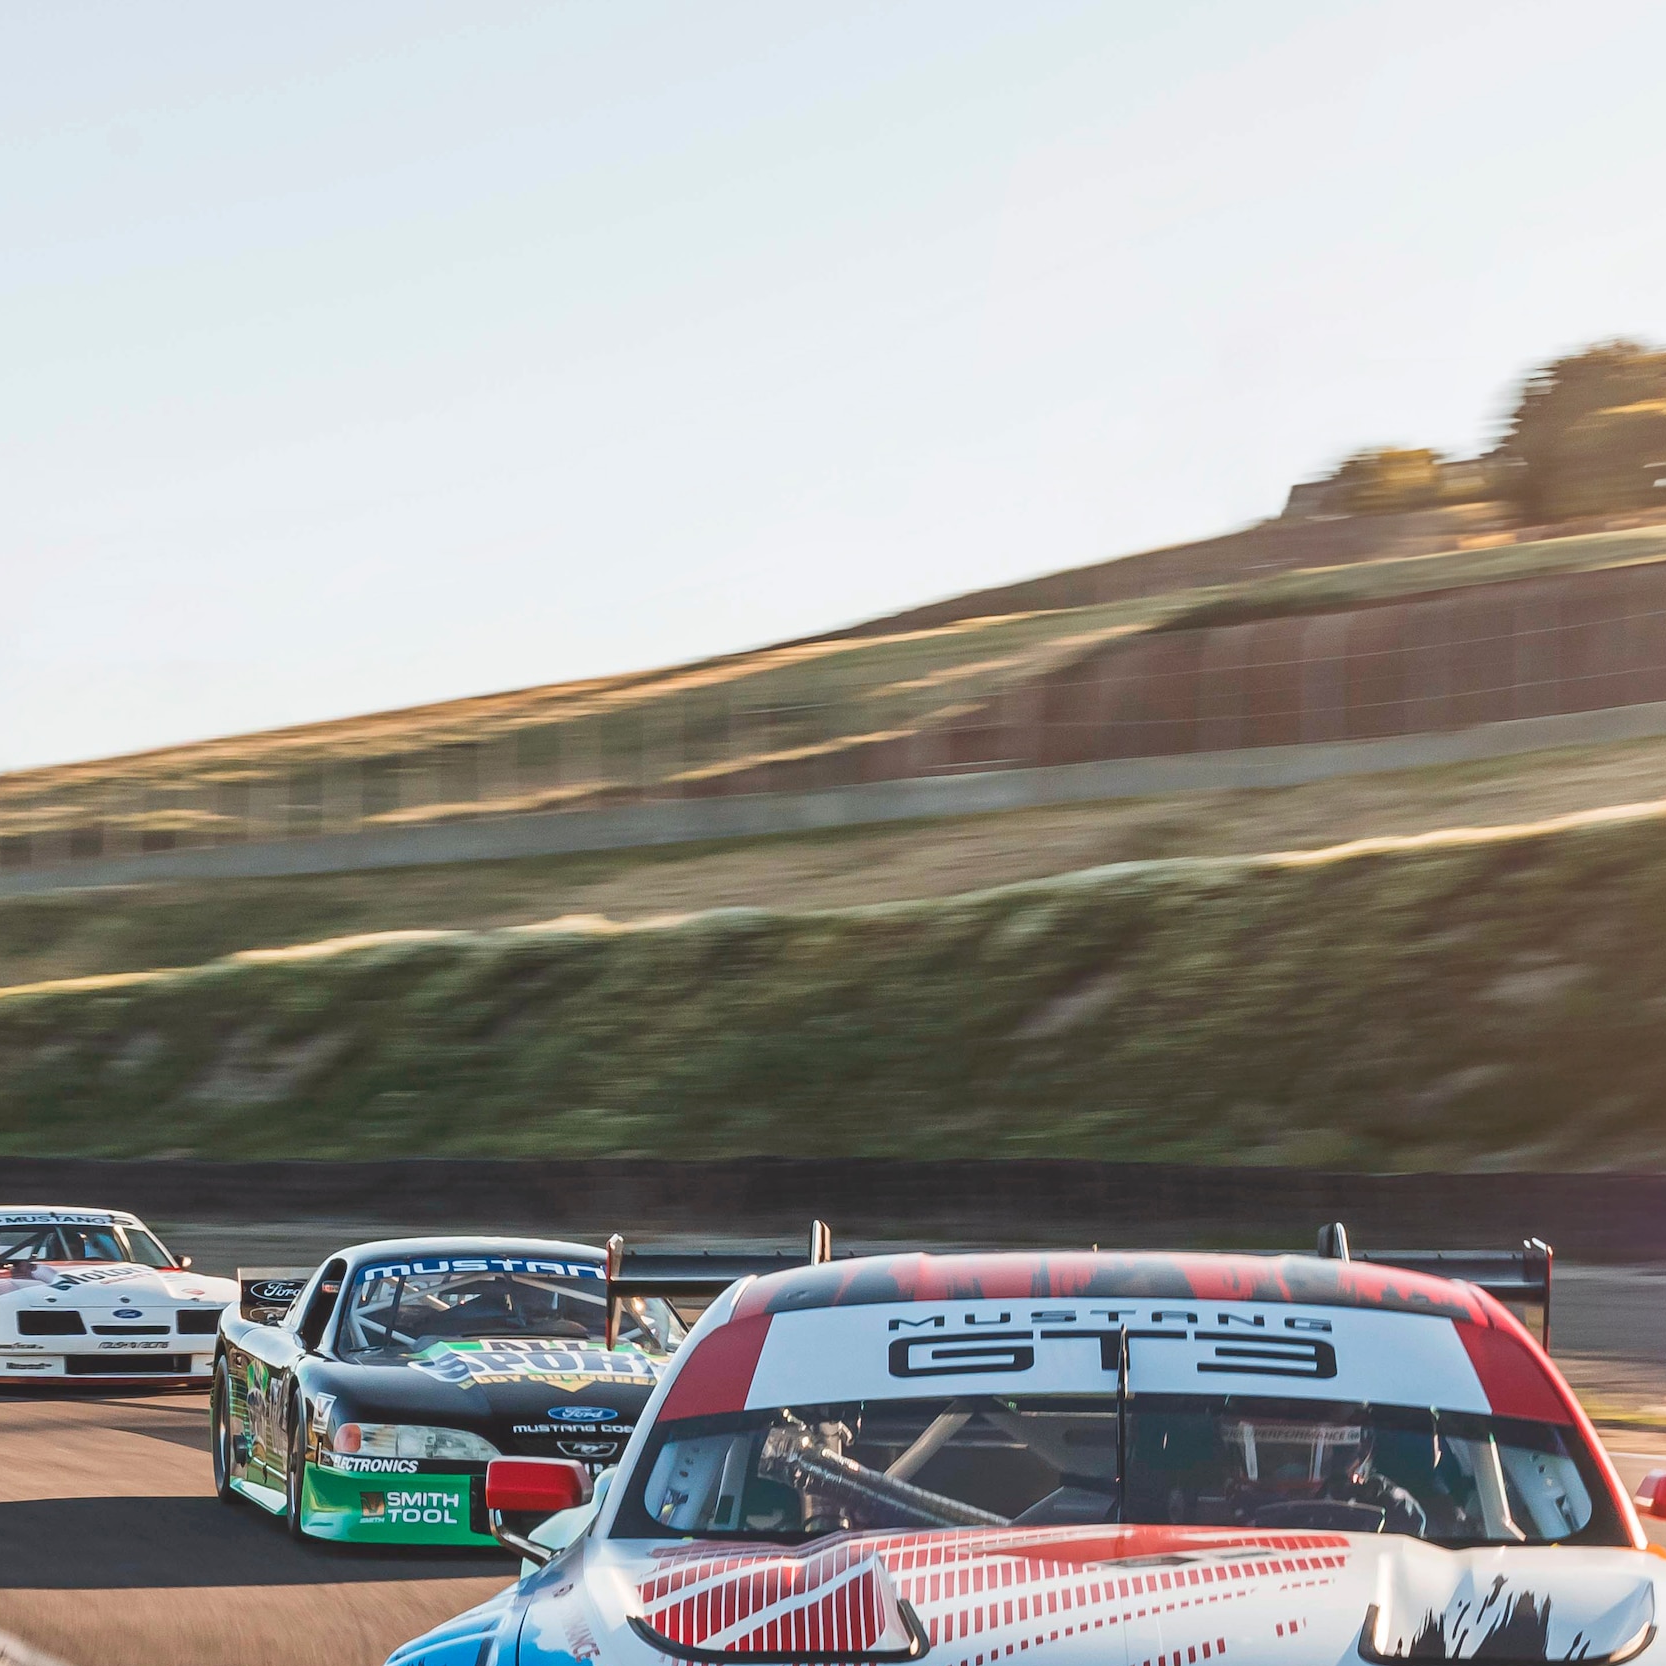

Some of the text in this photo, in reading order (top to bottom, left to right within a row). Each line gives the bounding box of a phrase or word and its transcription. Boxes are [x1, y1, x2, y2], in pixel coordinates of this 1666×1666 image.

[5, 1216, 106, 1224] MUSTANG
[364, 1259, 607, 1281] MUSTAN
[888, 1309, 1332, 1332] MUSTANG
[888, 1328, 1337, 1379] GT3
[513, 1424, 634, 1433] MUSTANG COB
[387, 1491, 459, 1507] SMITH
[387, 1508, 458, 1524] TOOL
